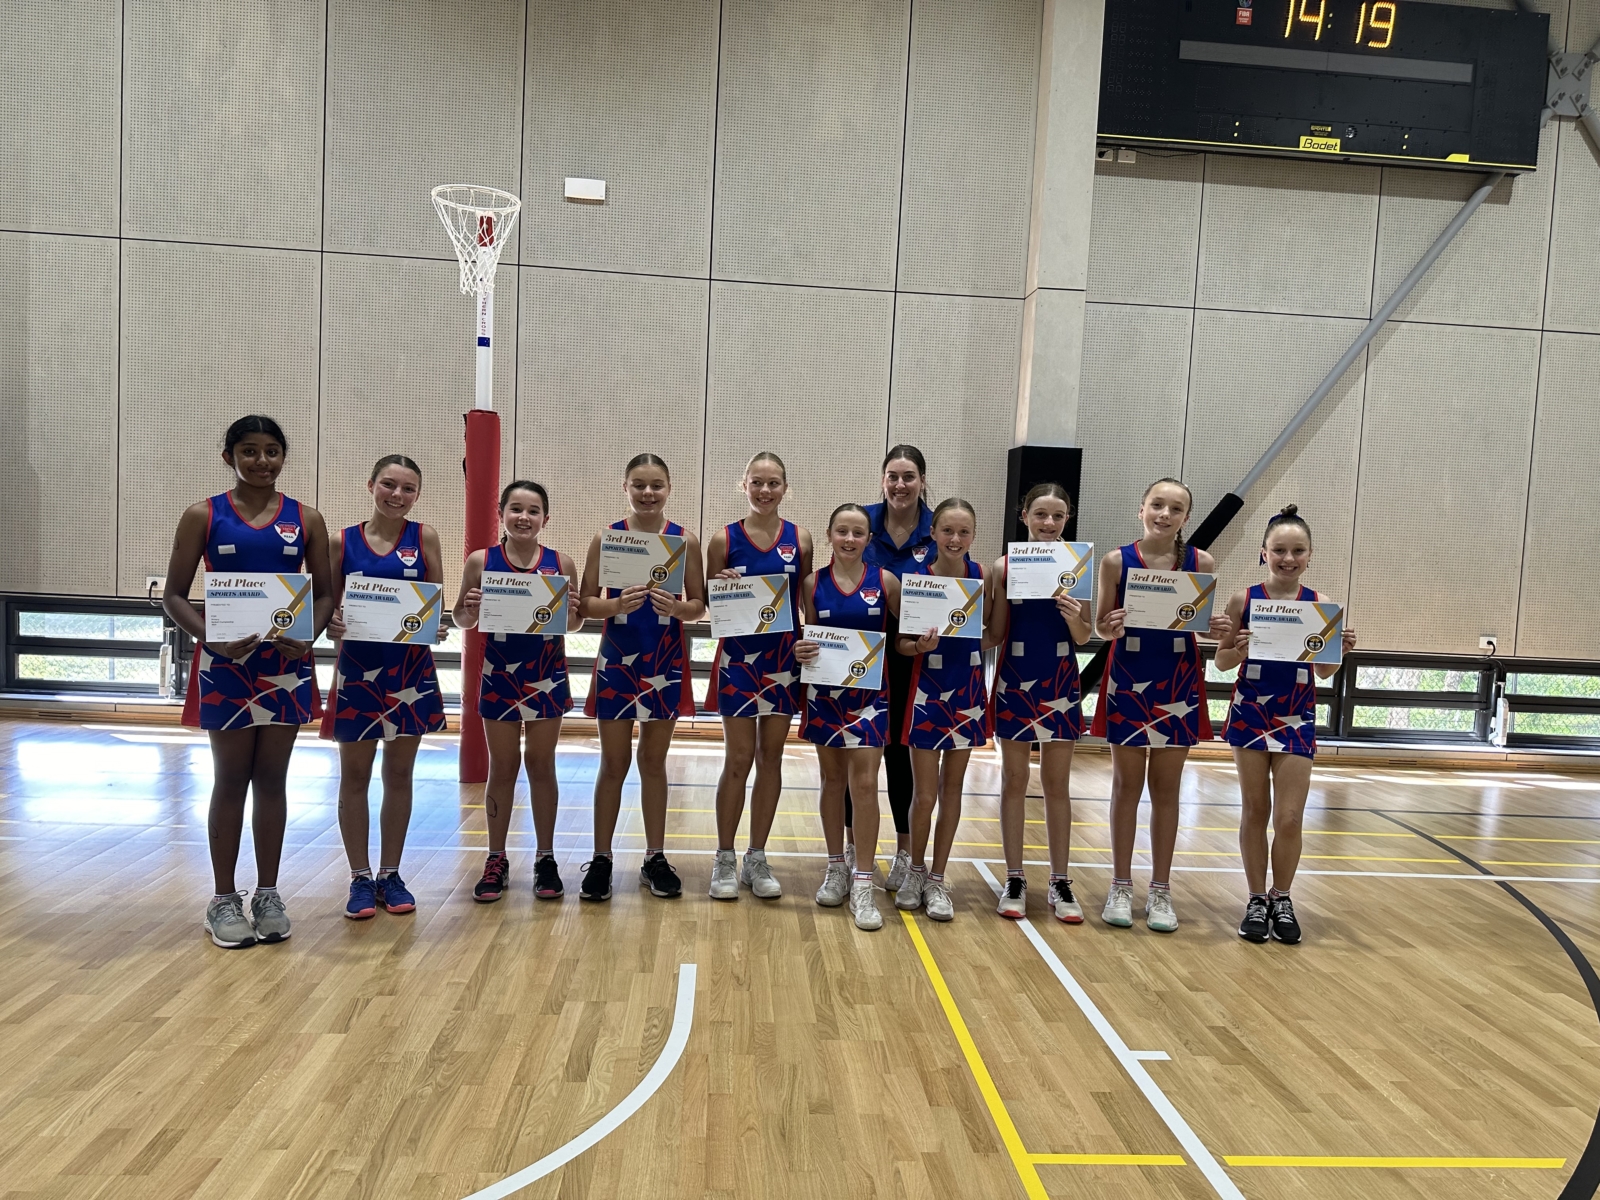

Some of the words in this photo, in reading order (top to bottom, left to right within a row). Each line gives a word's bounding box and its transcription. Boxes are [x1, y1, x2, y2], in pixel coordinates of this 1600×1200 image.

[1302, 138, 1338, 151] Bodet
[605, 534, 623, 544] 3rd
[623, 536, 650, 546] Place
[1012, 547, 1029, 555] 3rd
[1030, 547, 1056, 555] Place
[210, 578, 232, 588] 3rd
[234, 578, 266, 588] Place
[485, 577, 504, 585] 3rd
[505, 578, 532, 587] Place
[905, 579, 922, 587] 3rd
[923, 580, 947, 590] Place
[1131, 573, 1150, 582] 3rd
[1151, 575, 1178, 585] Place
[350, 581, 370, 591] 3rd
[371, 583, 400, 594] Place
[712, 583, 728, 592] 3rd
[729, 582, 754, 591] Place
[1255, 604, 1274, 613] 3rd
[1275, 605, 1303, 615] Place
[807, 630, 824, 639] 3rd
[824, 632, 850, 642] Place
